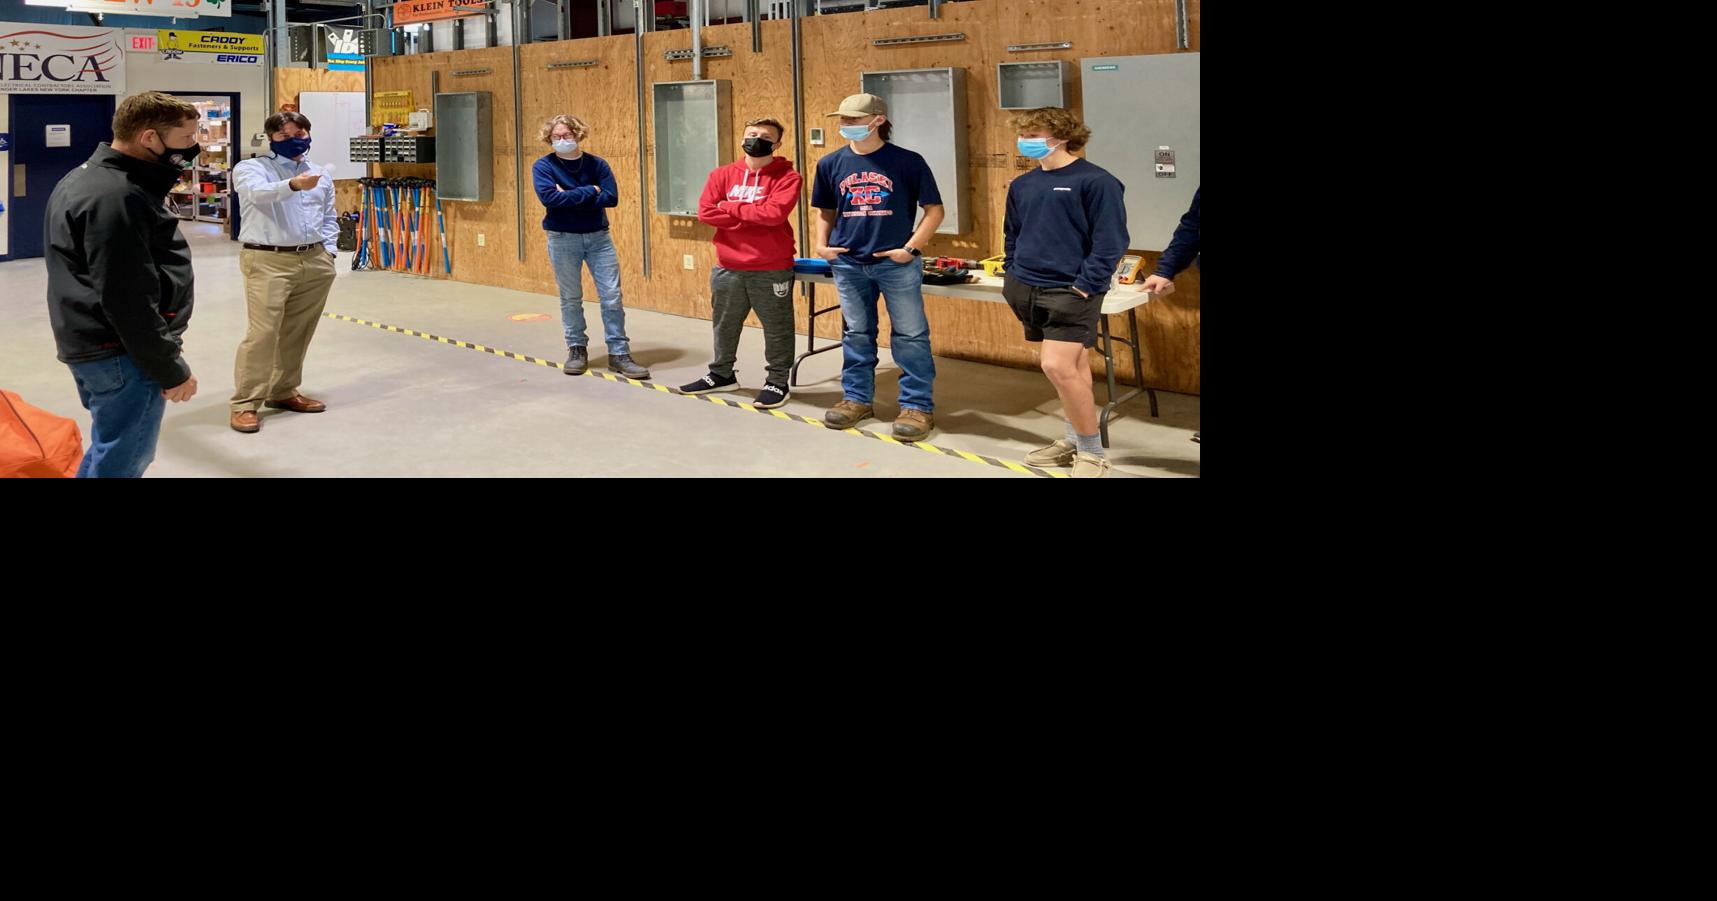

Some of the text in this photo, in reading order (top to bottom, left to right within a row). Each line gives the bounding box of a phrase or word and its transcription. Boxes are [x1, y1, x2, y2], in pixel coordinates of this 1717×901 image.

[413, 1, 444, 12] KLEIN
[132, 36, 154, 49] EXIT
[201, 35, 245, 44] CADDY
[216, 54, 258, 63] ERICO
[0, 52, 110, 82] ECA
[839, 172, 893, 196] PULASKI
[849, 186, 881, 205] XC
